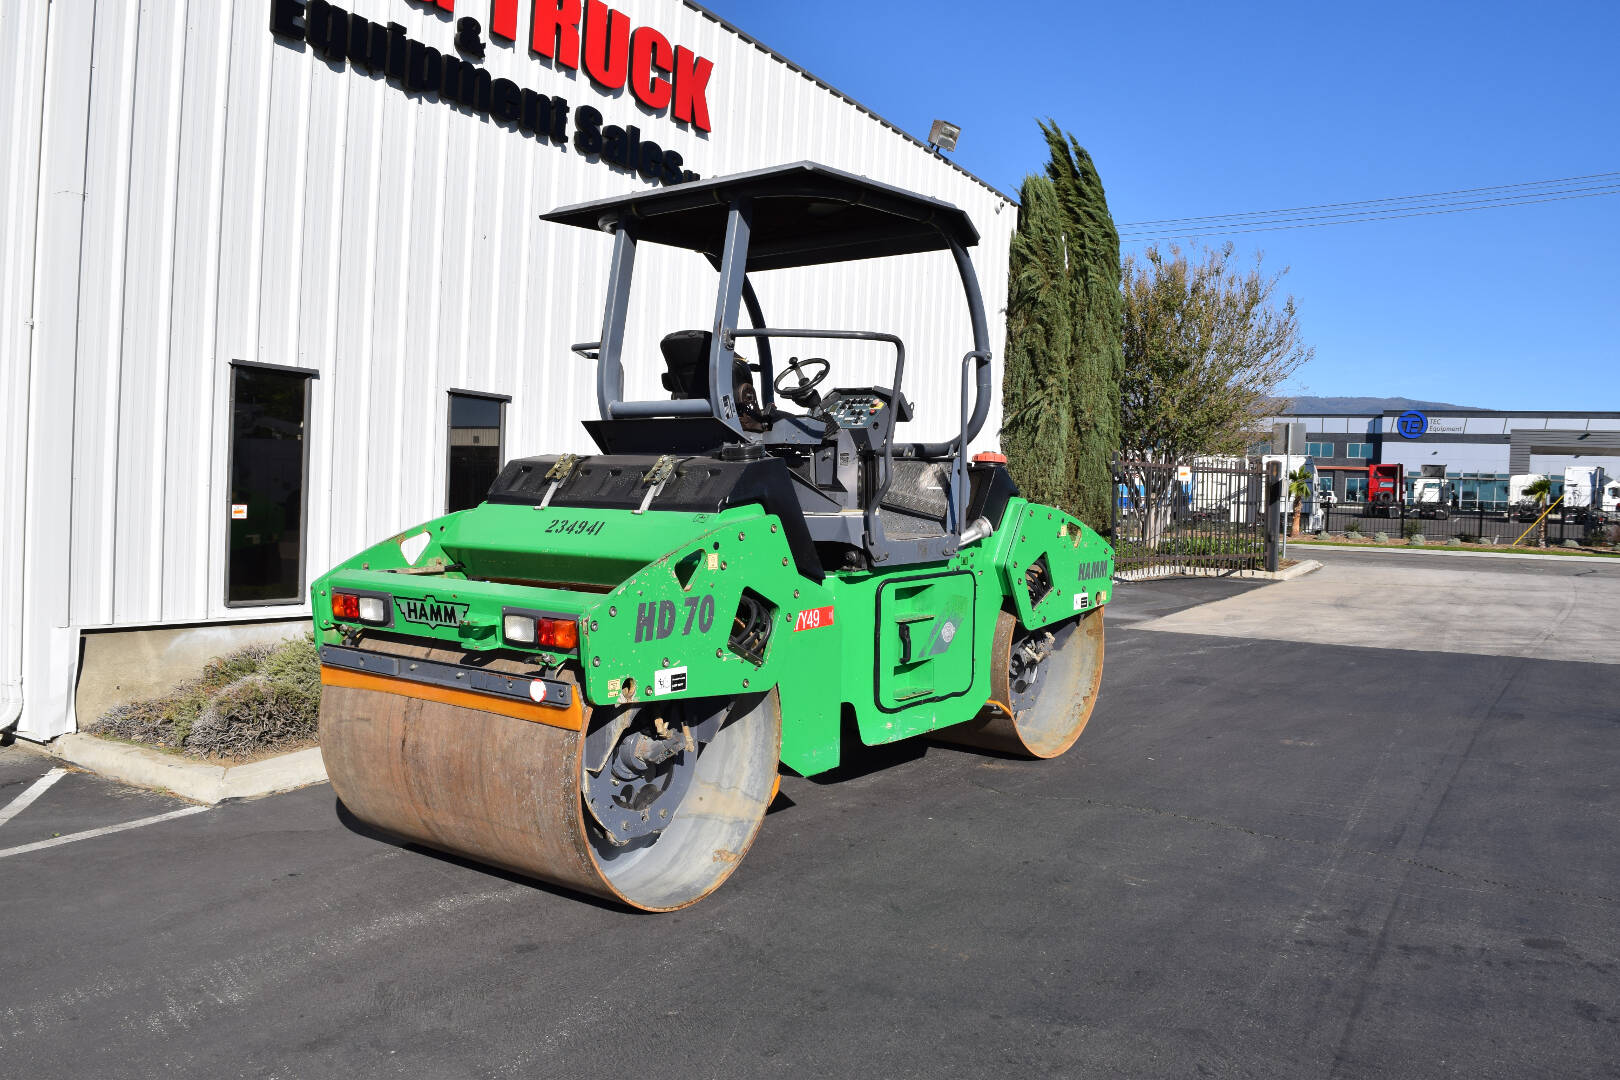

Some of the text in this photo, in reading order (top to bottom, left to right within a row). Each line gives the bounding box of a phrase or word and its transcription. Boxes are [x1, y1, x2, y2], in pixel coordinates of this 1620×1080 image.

[454, 16, 486, 60] &
[270, 0, 684, 187] Equipment Sales
[1429, 425, 1462, 433] Equipment
[544, 519, 606, 536] 234941
[1077, 559, 1108, 581] HAMM
[406, 601, 458, 625] HAMM
[634, 594, 715, 643] HD 70
